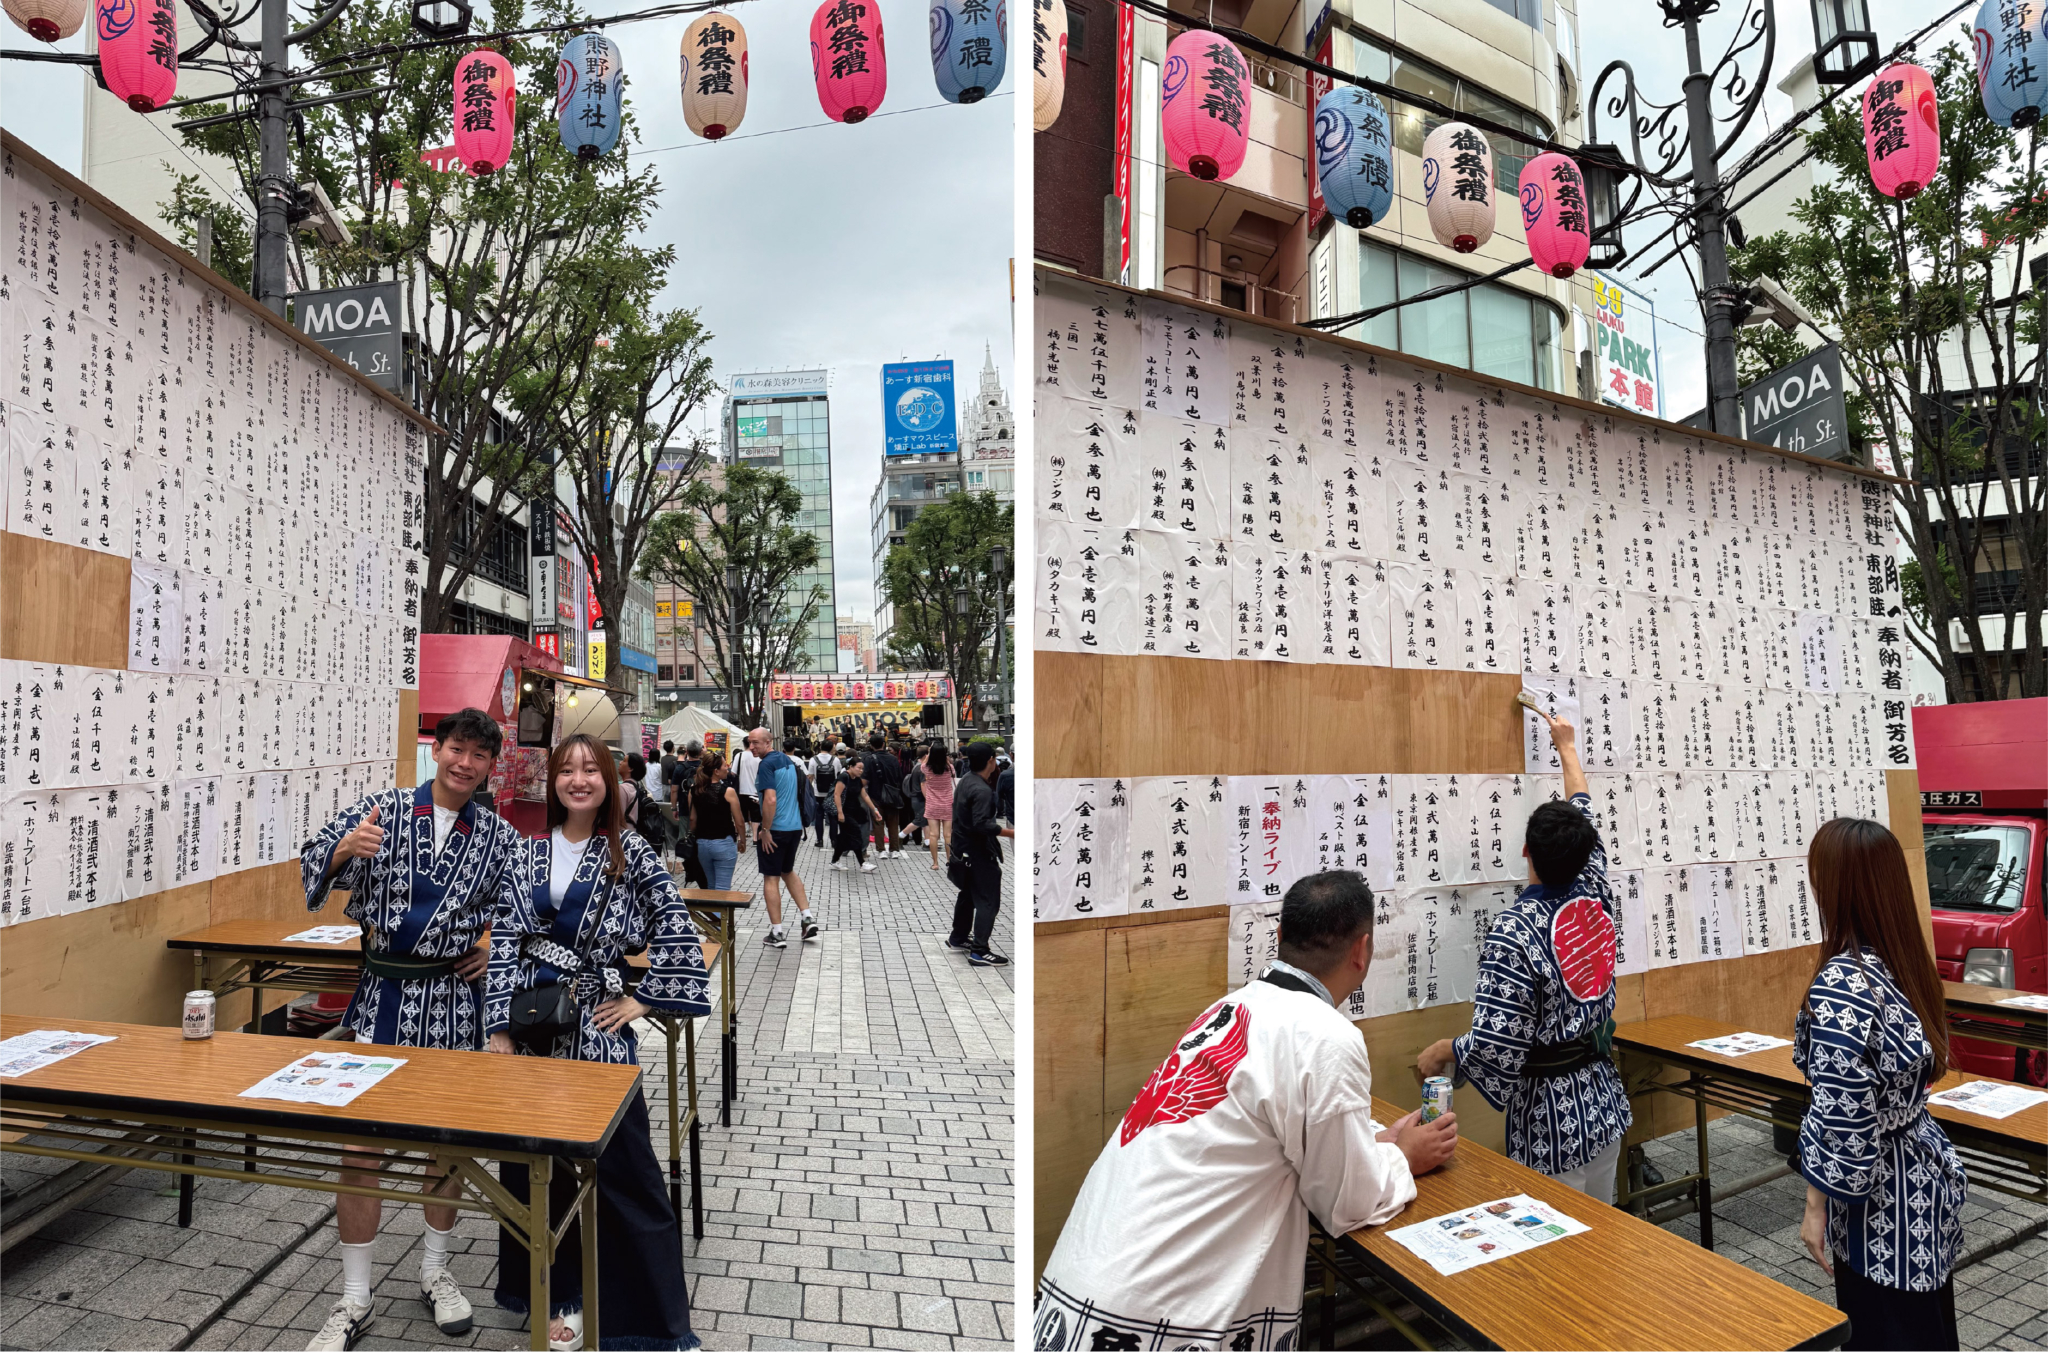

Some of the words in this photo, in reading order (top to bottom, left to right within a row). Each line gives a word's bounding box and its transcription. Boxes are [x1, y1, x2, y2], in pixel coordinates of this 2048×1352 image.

[696, 21, 736, 95] 御祭禮
[825, 0, 870, 79] 御祭禮
[1998, 0, 2040, 92] 野神社
[461, 59, 497, 132] 御祭禮
[578, 34, 609, 129] 熊野神社
[1199, 42, 1247, 136] 御祭禮
[1866, 79, 1911, 163] 御祭禮
[1352, 89, 1390, 193] 御祭禮
[1449, 128, 1489, 207] 御祭禮
[1551, 161, 1588, 238] 御祭禮
[303, 296, 392, 335] MOA
[1162, 315, 1173, 395] ヤマモトコーヒー店
[1597, 322, 1654, 382] PARK
[369, 351, 392, 373] St.
[747, 376, 825, 388] 水の森美容クリニック
[885, 372, 952, 385] あーす新宿歯科
[1145, 356, 1158, 410] 山本剛正殿
[1183, 312, 1201, 419] 一、金八萬円也
[1270, 333, 1288, 434] 一、金壱拾萬円也
[1609, 368, 1654, 412] 本館
[1752, 363, 1833, 426] MOA
[404, 419, 417, 486] 熊野神社
[887, 433, 956, 443] あーすマウスピース
[911, 442, 927, 450] Lab
[1385, 399, 1395, 447] 新宿支店殿
[1815, 418, 1837, 442] St.
[42, 421, 55, 536] 一、金壱萬円也
[99, 442, 112, 547] 一、金壱萬円也
[1085, 406, 1104, 522] 一、金参萬円也
[1180, 423, 1197, 531] 一、金参萬円也
[1344, 453, 1361, 551] 一、金参萬円也
[402, 490, 413, 549] 東部睦
[1414, 468, 1431, 562] 一、金参萬円也
[1477, 480, 1493, 563] 一、金参萬円也
[1861, 479, 1885, 547] 熊野神社
[151, 567, 163, 666] 一、金壱萬円也
[198, 576, 209, 670] 一、金壱萬円也
[404, 559, 418, 618] 奉納者
[1080, 530, 1099, 646] 一、金壱萬円也
[1184, 541, 1201, 653] 一、金壱萬円也
[1273, 551, 1289, 657] 一、金壱萬円也
[1345, 559, 1361, 659] 一、金壱萬円也
[1422, 569, 1438, 666] 一、金壱萬円也
[1482, 577, 1497, 667] 一、金壱萬円也
[1866, 553, 1886, 617] 東部睦
[402, 625, 417, 685] 御芳名
[1544, 584, 1559, 673] 一、金壱萬円也
[1598, 590, 1612, 678] 一、金壱萬円也
[1877, 627, 1903, 690] 奉納者
[712, 694, 729, 702] モア
[979, 684, 997, 693] モア
[1600, 681, 1614, 767] 一、金壱萬円也
[1883, 700, 1910, 764] 御芳名
[48, 793, 60, 823] 奉納
[107, 790, 118, 819] 奉納
[143, 790, 155, 882] 一、清酒弐本也
[160, 784, 170, 812] 奉納
[190, 785, 201, 872] 一、清酒弐本也
[1657, 774, 1672, 862] 一、金壱萬円也
[1704, 773, 1719, 858] 一、金壱萬円也
[1752, 773, 1767, 858] 一、金壱萬円也
[1, 842, 14, 914] 佐武精肉店殿
[20, 800, 37, 916] 一、ホットプレート一台也
[85, 797, 100, 903] 一、清酒弐本也
[1074, 783, 1095, 912] 一、金壱萬円也
[1238, 805, 1251, 892] 新宿ケントス殿
[1396, 809, 1406, 883] セキネ新宿店殿
[1679, 868, 1688, 892] 奉納
[1724, 866, 1733, 890] 奉納
[1769, 862, 1778, 885] 奉納
[1377, 896, 1390, 925] 奉納
[1450, 889, 1461, 916] 奉納
[1628, 874, 1638, 899] 奉納
[1664, 872, 1678, 960] 一、清酒弐本也
[1710, 870, 1722, 956] 一、チューハイ一箱也
[1744, 883, 1755, 945] ルミネエスト殿
[1754, 867, 1770, 948] 一、清酒弐本也
[1407, 933, 1418, 998] 佐武精肉店殿
[1424, 896, 1438, 1000] 一、ホットプレート一台也
[185, 1013, 206, 1022] Asahi
